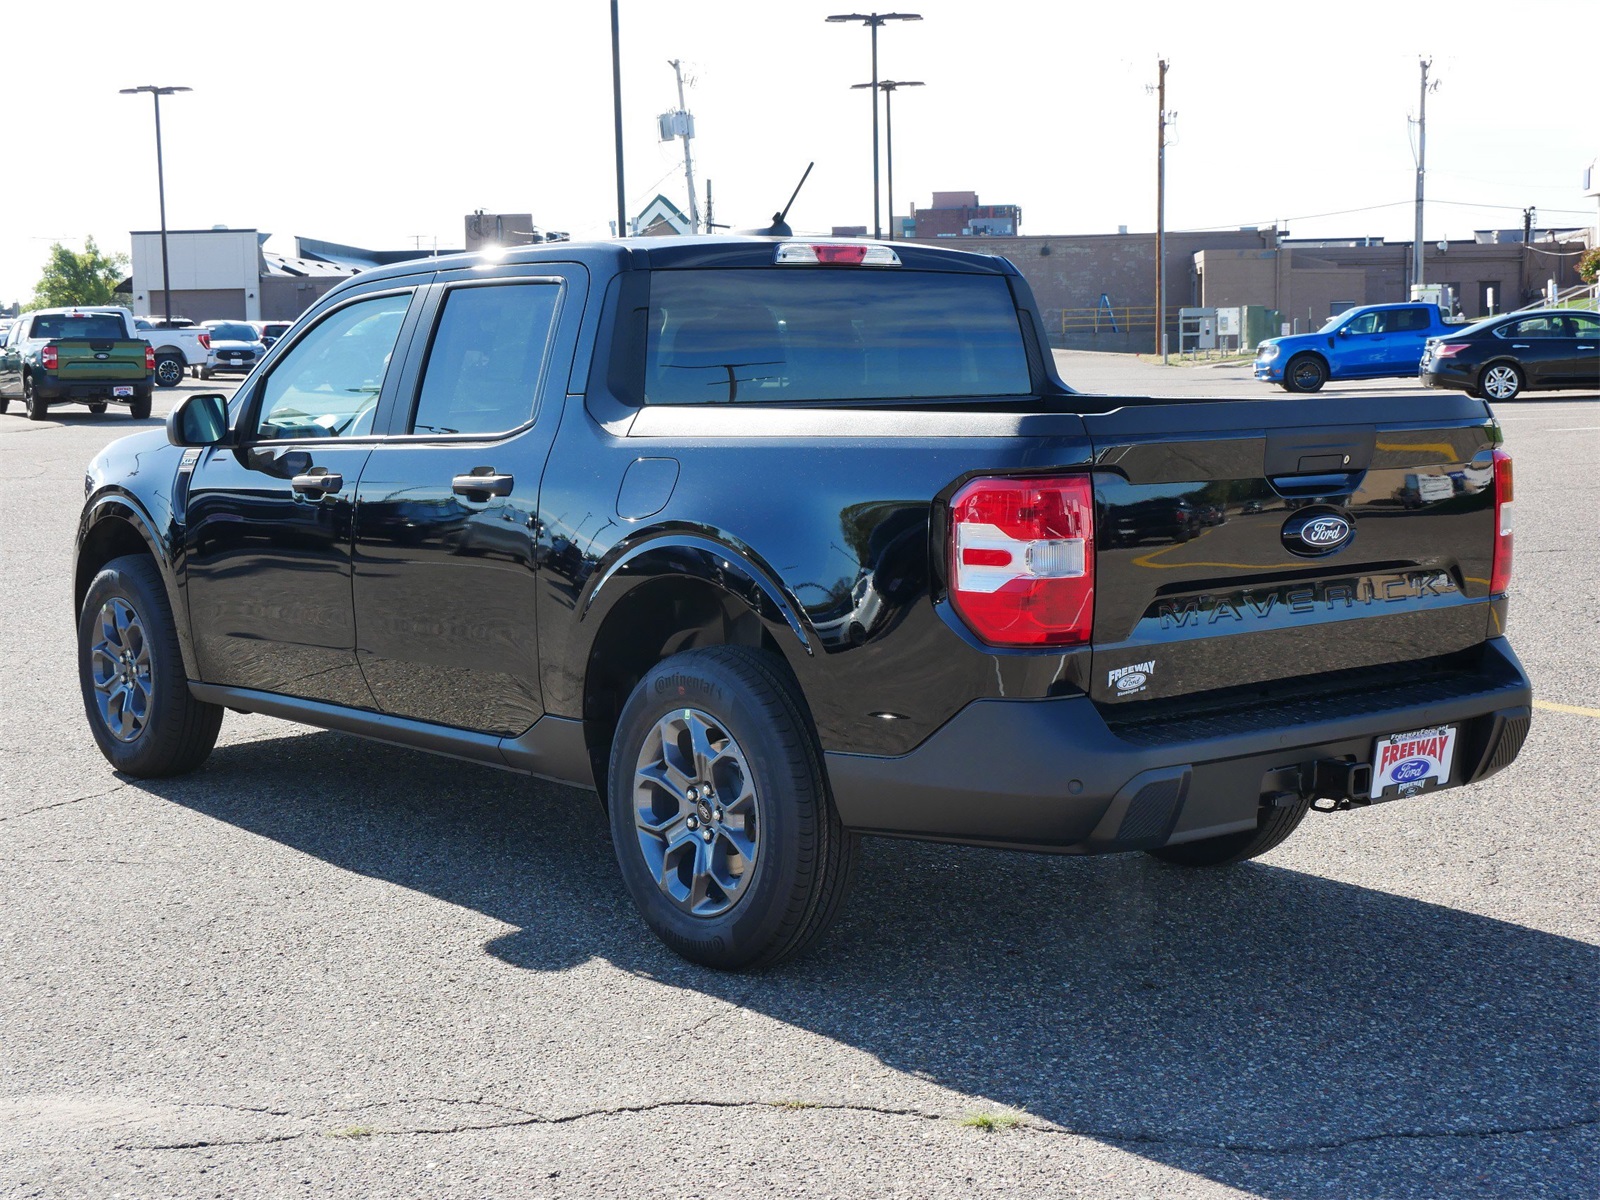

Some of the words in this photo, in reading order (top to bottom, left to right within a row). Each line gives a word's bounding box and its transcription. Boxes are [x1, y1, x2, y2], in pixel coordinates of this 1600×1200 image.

[1311, 522, 1341, 541] Ford
[1159, 574, 1440, 629] MAVERICK
[655, 671, 715, 695] Continental
[1108, 660, 1155, 687] FREEWAY
[1379, 736, 1448, 778] FREEWAY
[1397, 762, 1422, 779] Ford
